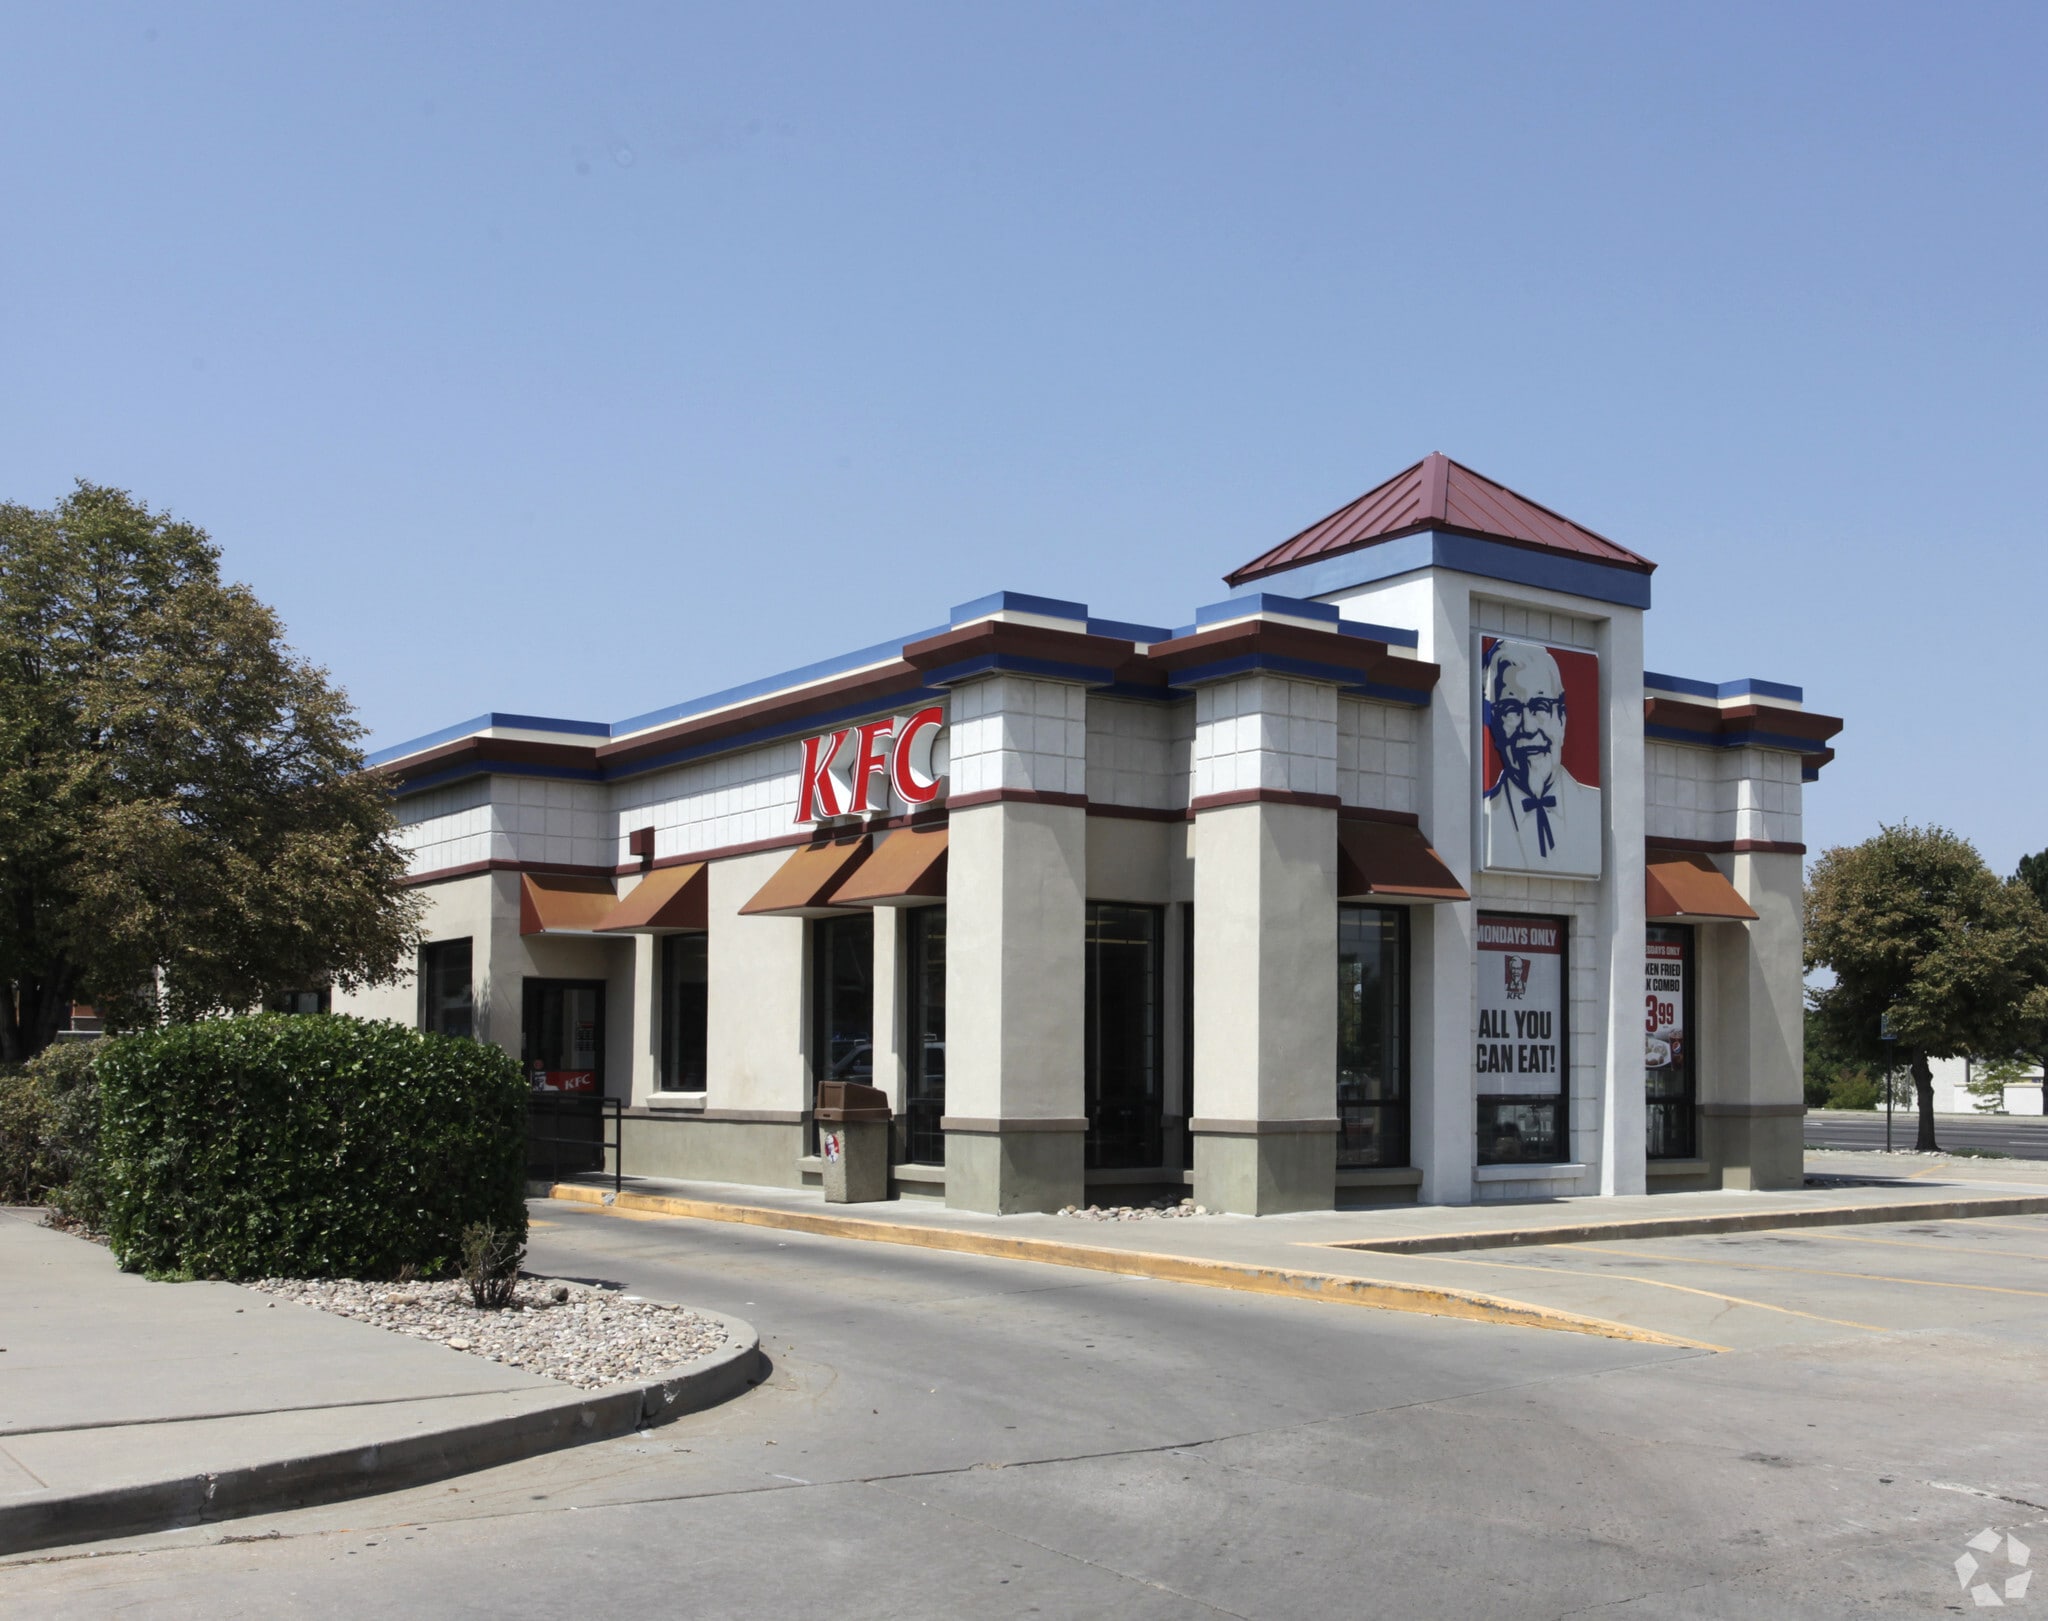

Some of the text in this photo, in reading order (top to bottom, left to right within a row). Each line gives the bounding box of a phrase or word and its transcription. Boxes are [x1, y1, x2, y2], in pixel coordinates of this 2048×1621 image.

[793, 706, 943, 824] KFC
[1530, 928, 1557, 946] ONLY
[1666, 946, 1680, 956] ONLY
[1660, 963, 1681, 976] FRIED
[1652, 978, 1680, 992] COMBO
[1506, 992, 1523, 1000] KFC
[1478, 1009, 1552, 1040] ALL YOU
[1476, 1043, 1556, 1073] CAN EAT!
[564, 1073, 592, 1091] KFC
